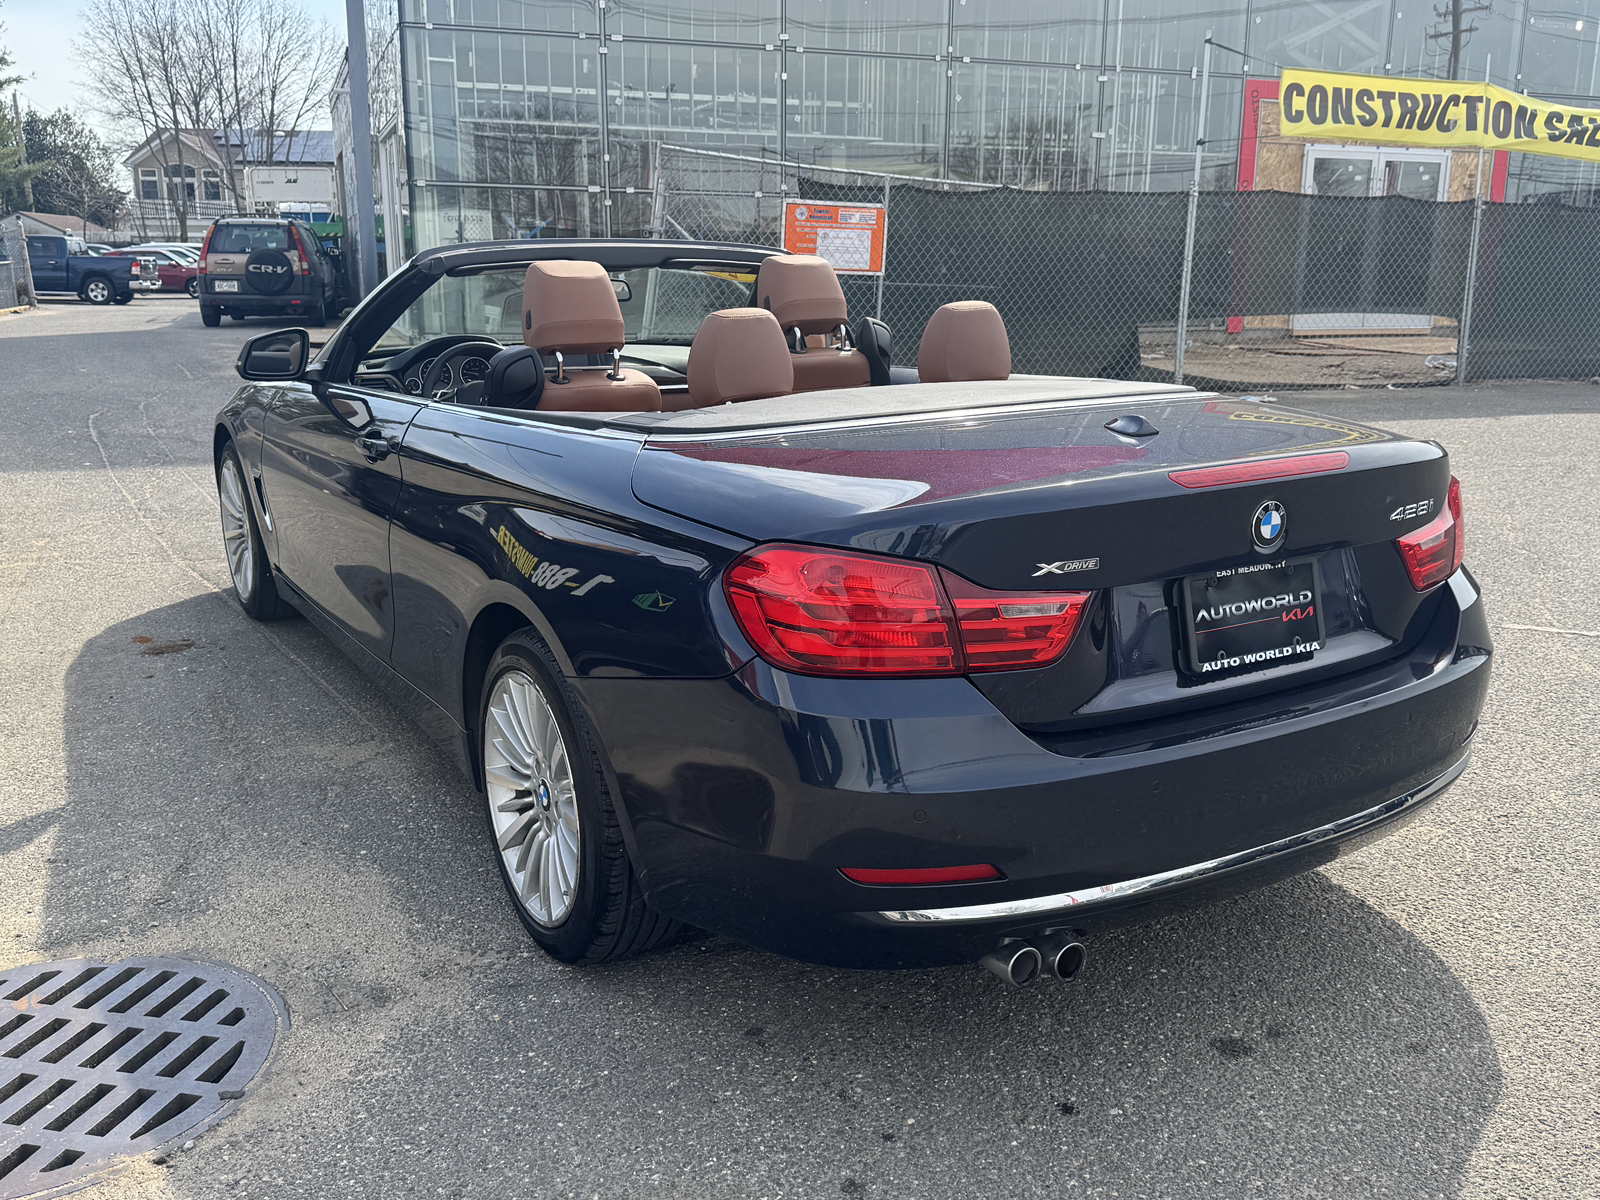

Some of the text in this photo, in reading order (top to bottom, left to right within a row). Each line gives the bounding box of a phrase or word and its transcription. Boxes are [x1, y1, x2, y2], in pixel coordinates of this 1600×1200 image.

[1283, 82, 1538, 140] CONSTRUCTION
[1258, 502, 1285, 519] BMW
[1390, 498, 1434, 521] 428i
[1275, 560, 1286, 569] Y
[1195, 590, 1312, 624] AUTOWORLD
[1282, 605, 1315, 622] KIA
[1202, 641, 1321, 673] AUTO WORLD KIA
